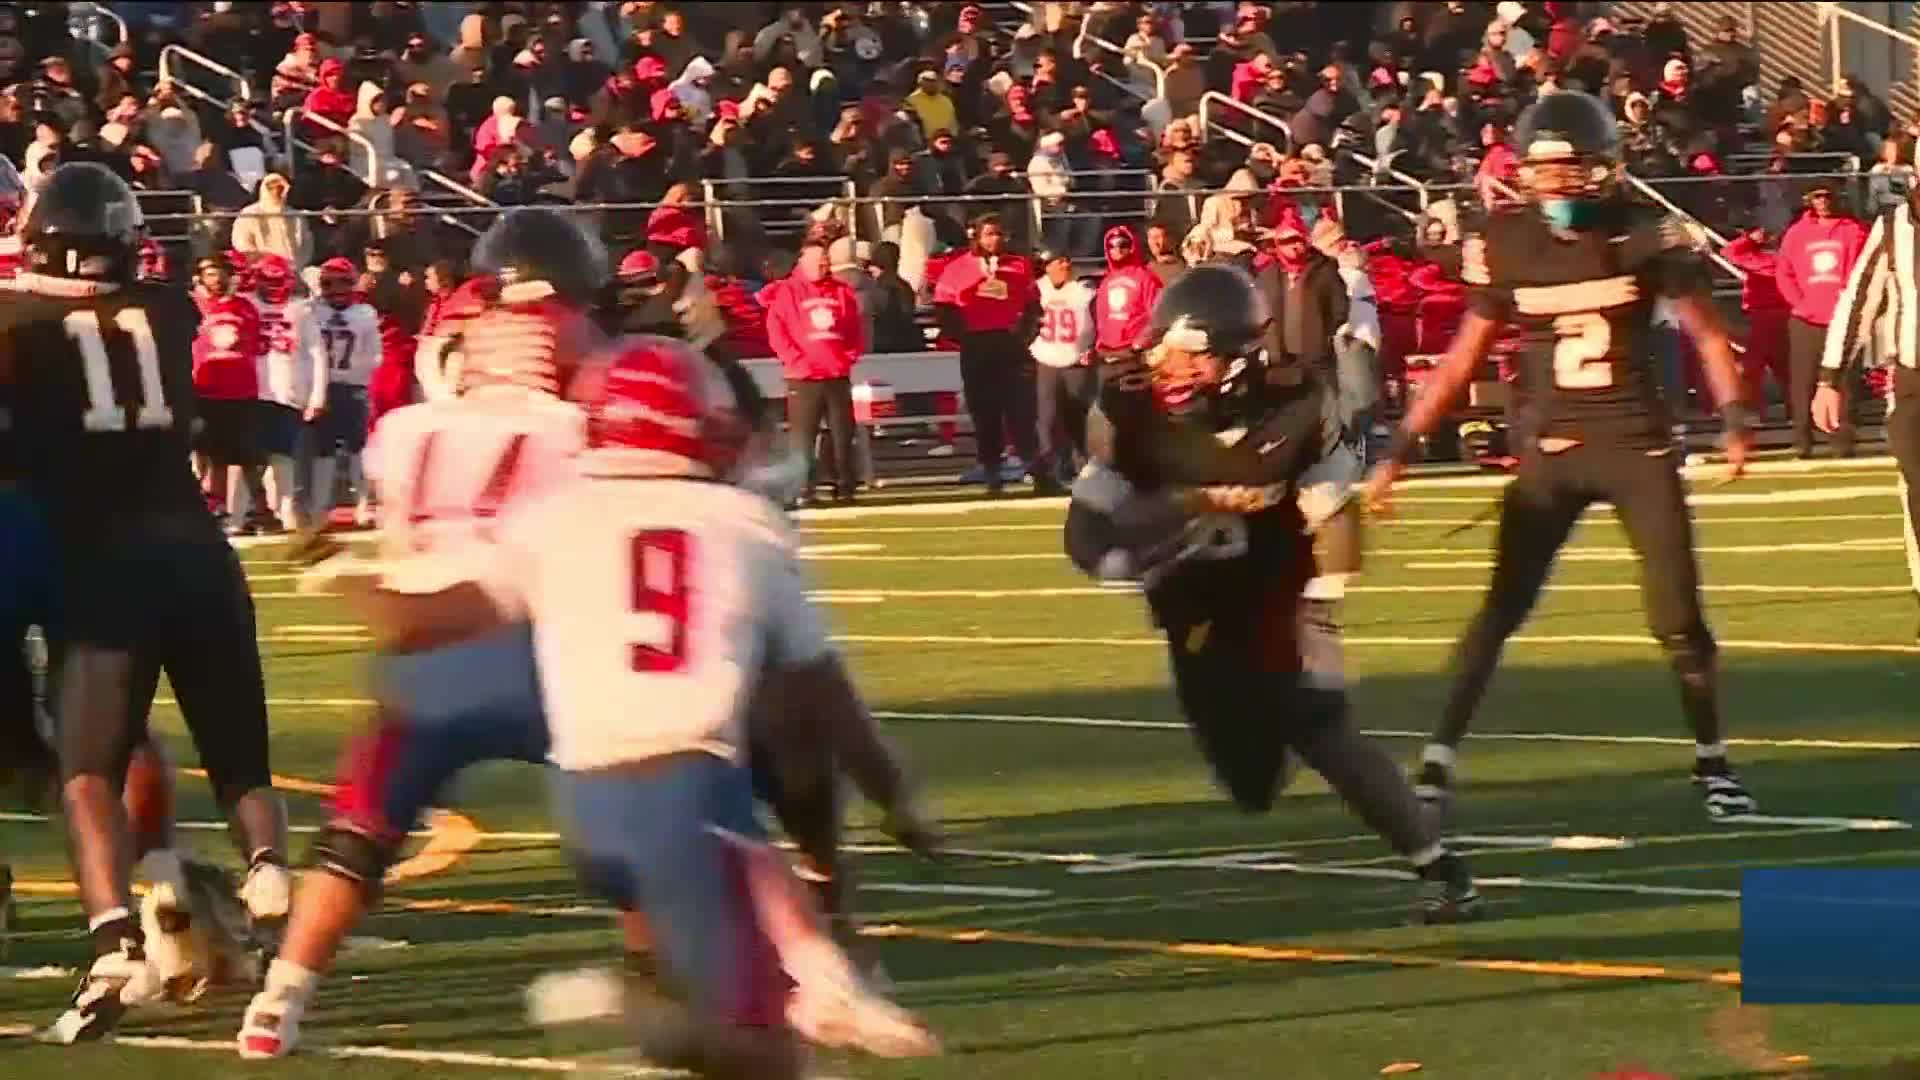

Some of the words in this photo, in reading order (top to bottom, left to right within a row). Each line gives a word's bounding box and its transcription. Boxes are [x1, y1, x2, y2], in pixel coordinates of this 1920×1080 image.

[63, 307, 173, 431] 11
[1553, 312, 1613, 389] 2
[631, 528, 687, 673] 9
